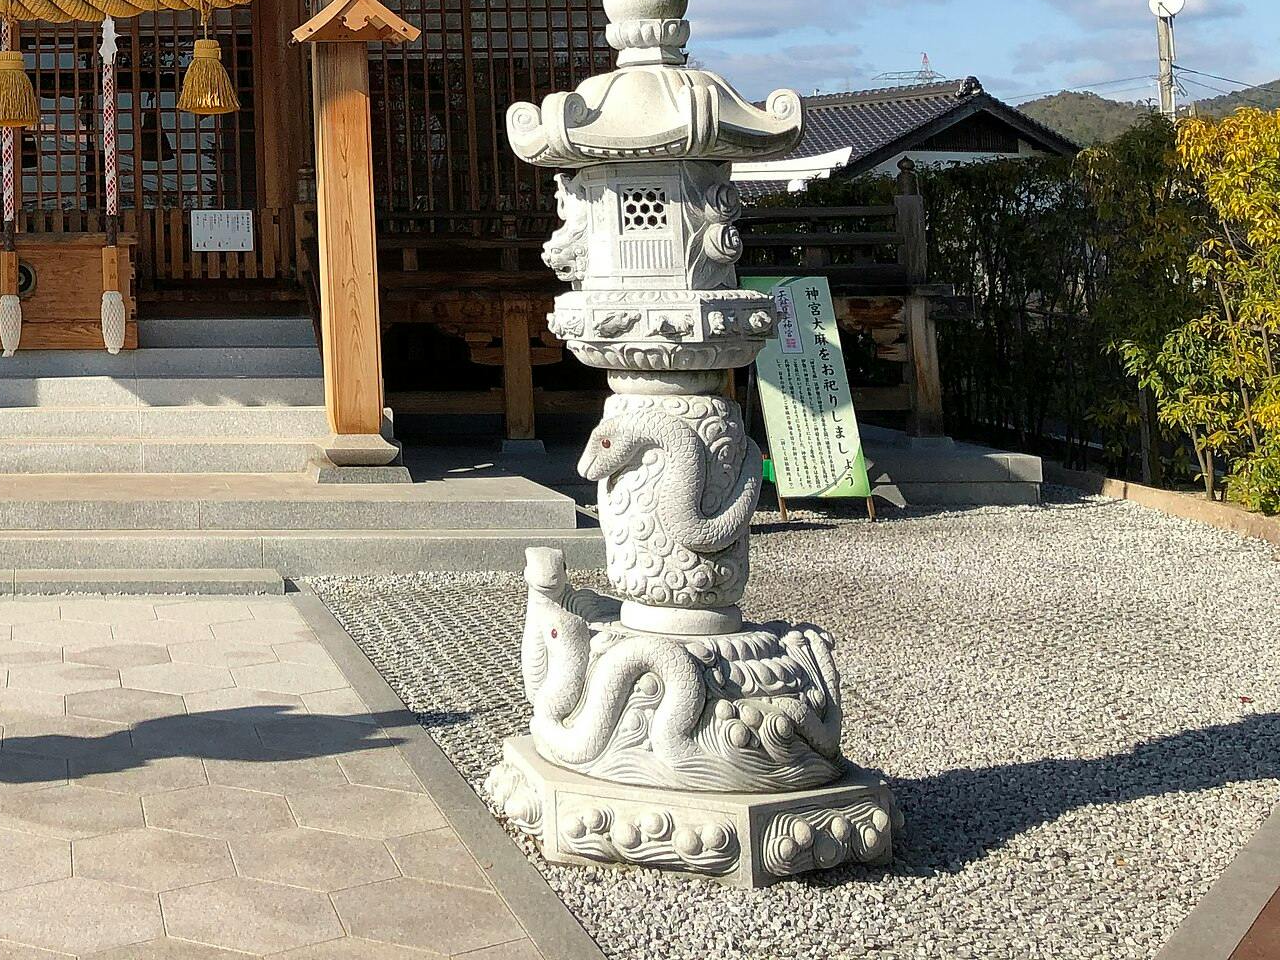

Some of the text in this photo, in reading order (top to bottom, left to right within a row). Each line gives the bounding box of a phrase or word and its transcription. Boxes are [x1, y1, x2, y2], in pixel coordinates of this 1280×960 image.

[804, 286, 854, 487] 神宮大麻をお祀りしましょう
